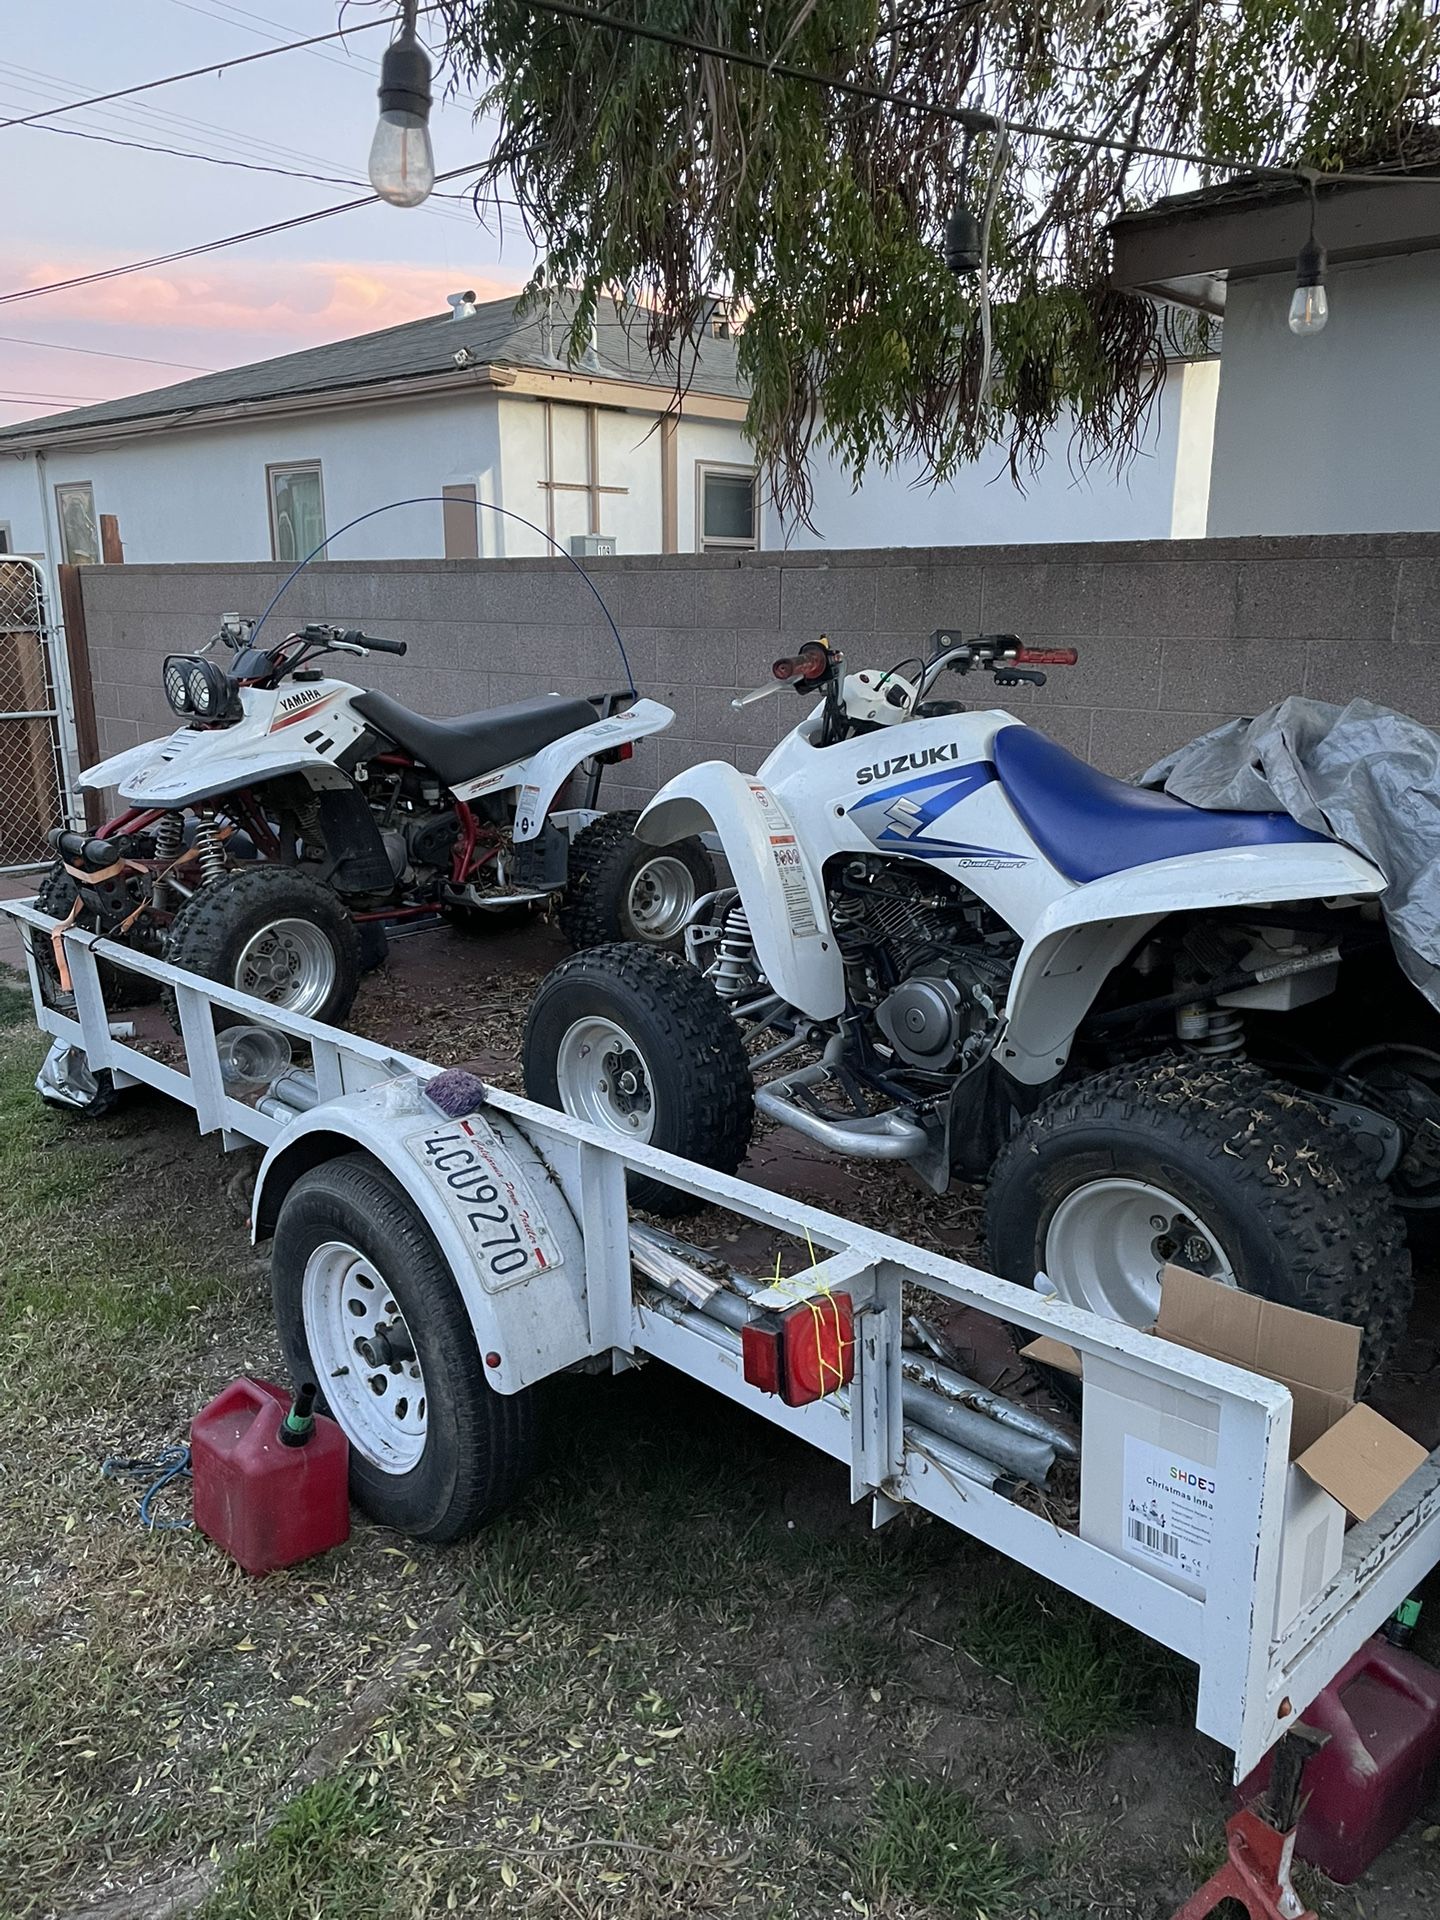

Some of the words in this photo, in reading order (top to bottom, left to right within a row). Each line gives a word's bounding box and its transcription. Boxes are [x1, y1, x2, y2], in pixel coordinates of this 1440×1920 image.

[280, 689, 321, 711] YAMAHA
[856, 743, 959, 785] SUZUKI
[958, 859, 1027, 870] QuadSport
[424, 1135, 528, 1275] 4CU9270
[471, 1139, 504, 1178] California
[519, 1210, 537, 1244] Trailer
[1146, 1476, 1191, 1501] Christmas
[1193, 1496, 1213, 1510] Infla
